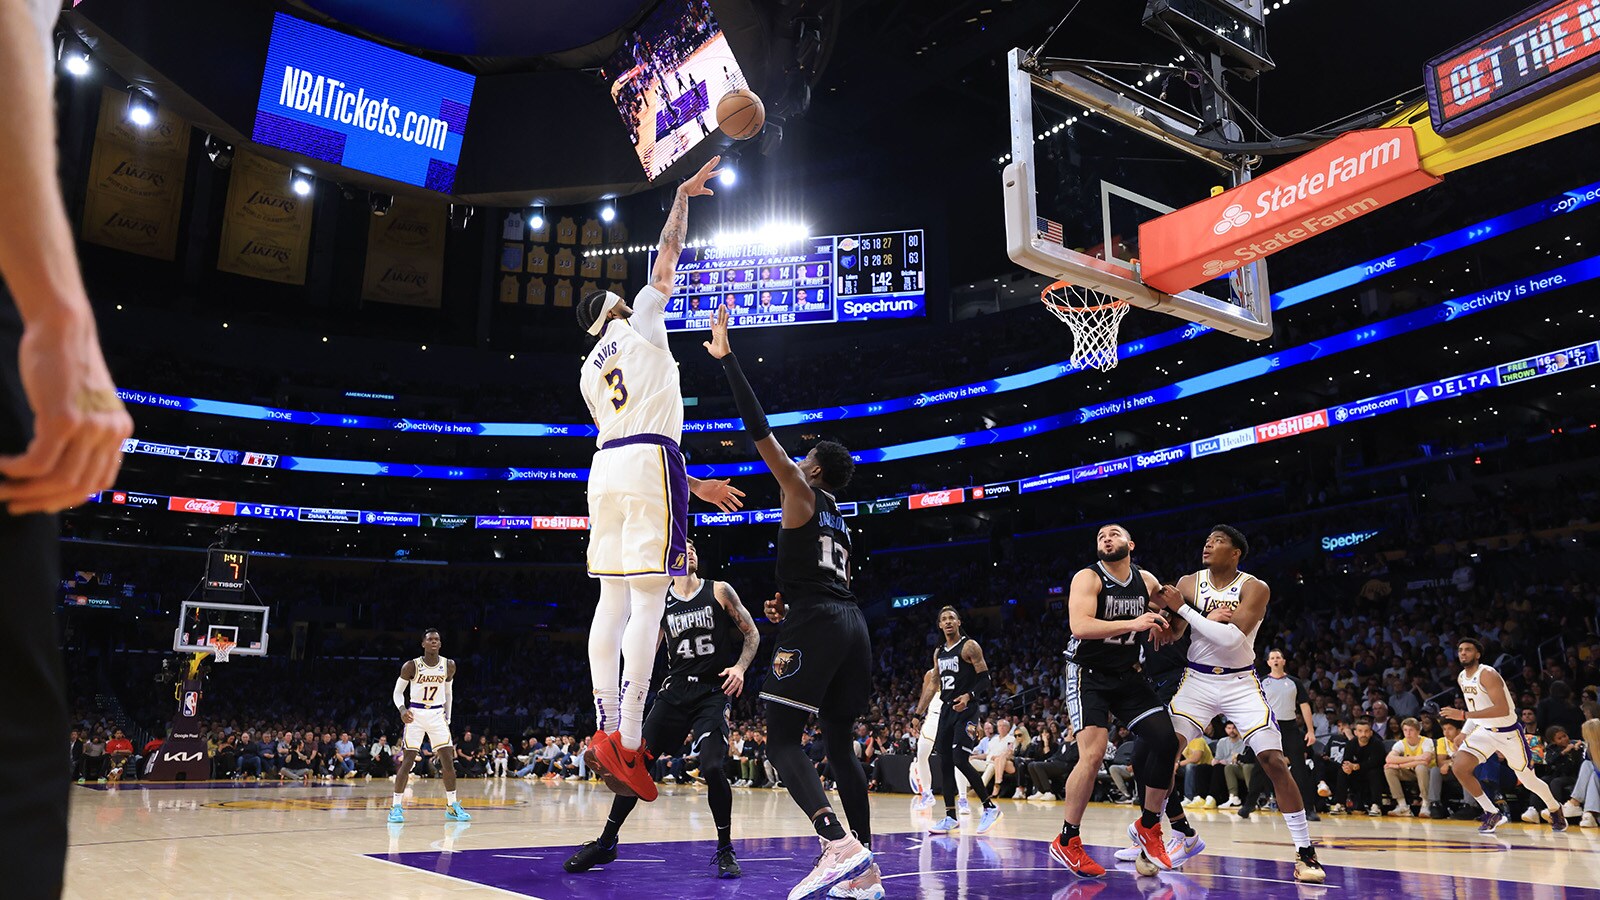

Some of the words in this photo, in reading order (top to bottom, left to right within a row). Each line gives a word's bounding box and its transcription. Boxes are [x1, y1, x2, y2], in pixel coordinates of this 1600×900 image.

[1450, 46, 1503, 106] GET
[1509, 13, 1575, 76] THE
[279, 65, 448, 151] NBATickets.com
[112, 161, 165, 187] LAKERS
[246, 190, 297, 213] LAKERS
[103, 212, 159, 237] LAKERS
[862, 239, 871, 250] 35
[873, 238, 881, 249] 18
[882, 237, 892, 248] 27
[908, 235, 918, 247] 80
[240, 240, 292, 264] LAKERS
[704, 245, 741, 260] SCORING
[908, 252, 918, 264] 63
[702, 258, 755, 270] ANGELES
[863, 255, 869, 266] 9
[872, 254, 881, 266] 28
[883, 254, 892, 265] 26
[744, 269, 754, 282] 15
[779, 267, 790, 279] 14
[816, 264, 824, 277] 8
[675, 274, 686, 286] 22
[709, 272, 719, 284] 19
[871, 271, 892, 286] 1:42
[1515, 284, 1527, 296] is
[1529, 273, 1567, 292] here.
[709, 296, 718, 308] 11
[744, 294, 754, 306] 10
[781, 291, 788, 304] 7
[817, 289, 824, 302] 6
[673, 298, 684, 311] 21
[844, 300, 914, 316] Spectrum
[686, 315, 735, 329] MEMS
[739, 313, 796, 325] GRIZZLIES
[593, 341, 617, 370] DAVIS
[1574, 356, 1587, 366] 17
[1507, 361, 1528, 372] FREE
[1545, 364, 1558, 373] 20
[1502, 368, 1535, 382] THROWS
[604, 367, 629, 414] 3
[960, 388, 967, 396] is
[968, 385, 988, 395] here.
[1432, 373, 1491, 397] DELTA
[149, 395, 156, 403] is
[159, 396, 182, 407] here.
[345, 391, 371, 399] AMERICAN
[1123, 400, 1132, 409] is
[1133, 395, 1155, 407] here.
[1349, 397, 1398, 416] crypto.com
[445, 424, 451, 432] is
[454, 424, 473, 433] here.
[706, 421, 713, 429] is
[714, 421, 734, 429] here.
[1258, 413, 1325, 439] TOSHIBA
[126, 443, 133, 452] 3
[1198, 439, 1218, 452] UCLA
[1222, 432, 1252, 447] Health
[143, 444, 180, 456] Grizzlies
[194, 449, 211, 460] 63
[1136, 448, 1183, 467] Spectrum
[550, 470, 557, 478] is
[559, 469, 578, 478] here.
[1103, 462, 1129, 473] ULTRA
[1022, 479, 1047, 489] AMERICAN
[1048, 475, 1070, 484] EXPRESS
[985, 485, 1011, 495] TOYOTA
[128, 495, 158, 505] TOYOTA
[254, 506, 295, 518] DELTA
[377, 515, 413, 523] crypto.com
[535, 518, 586, 528] TOSHIBA
[701, 514, 743, 525] Spectrum
[1321, 530, 1376, 551] Spect
[223, 553, 243, 564] 1:41
[229, 563, 240, 580] 7
[219, 581, 243, 589] TISSOT
[1104, 595, 1146, 620] MEMPHIS
[666, 605, 715, 639] MEMPHIS
[676, 635, 716, 660] 46
[938, 656, 960, 675] MEMPHIS
[417, 673, 445, 684] LAKERS
[940, 675, 956, 690] 12
[422, 686, 439, 701] 17
[1462, 685, 1478, 695] AKERS
[1467, 697, 1477, 711] 7
[163, 752, 203, 761] KIA
